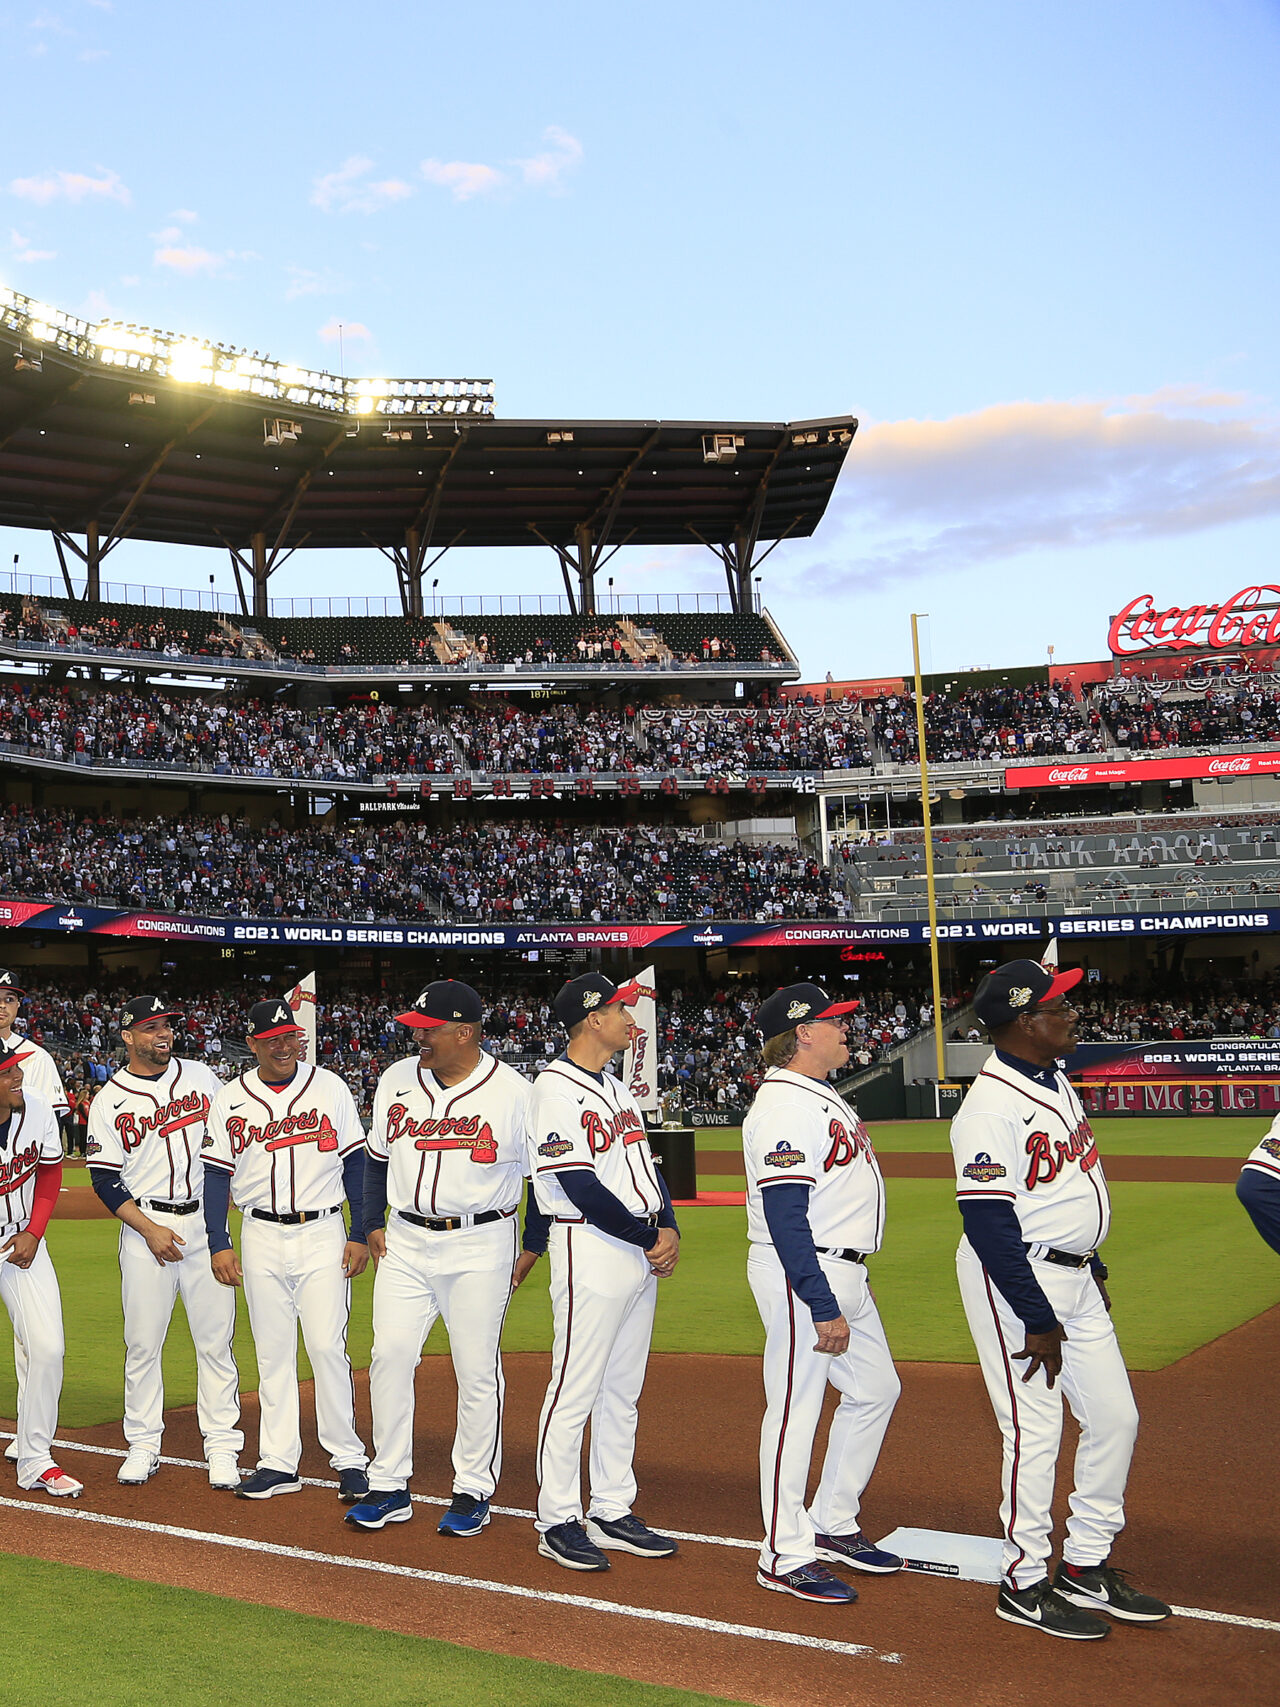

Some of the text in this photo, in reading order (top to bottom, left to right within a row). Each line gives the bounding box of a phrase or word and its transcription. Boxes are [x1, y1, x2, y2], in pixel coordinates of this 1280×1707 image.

[1209, 758, 1252, 774] Coca-Cola
[1049, 768, 1089, 782] Coca-Cola
[386, 781, 398, 797] 3
[420, 780, 433, 796] 6
[453, 780, 472, 796] 10
[492, 779, 512, 796] 21
[530, 779, 555, 796] 29
[575, 779, 595, 795] 31
[617, 778, 641, 795] 35
[659, 777, 679, 794] 41
[704, 777, 730, 794] 44
[745, 777, 768, 793] 47
[792, 776, 816, 793] 42
[360, 802, 396, 812] BALLPARK
[137, 919, 629, 945] CONGRATULATIONS 2021 WORLD SERIES CHAMPIONS ATLANTA BRAVES
[785, 928, 910, 940] CONGRATULATIONS
[922, 924, 976, 939] 2021
[1059, 918, 1135, 934] SERIES
[1140, 913, 1269, 931] CHAMPIONS
[1144, 1054, 1181, 1063] 2021
[1185, 1053, 1235, 1062] WORLD
[942, 1090, 957, 1098] 335
[115, 1091, 201, 1154] Braves
[387, 1103, 480, 1149] Braves
[705, 1114, 730, 1124] WISE
[226, 1108, 319, 1158] Braves
[538, 1141, 573, 1154] CHAMPIONS
[765, 1151, 806, 1164] CHAMPIONS
[963, 1165, 1007, 1178] CHAMPIONS
